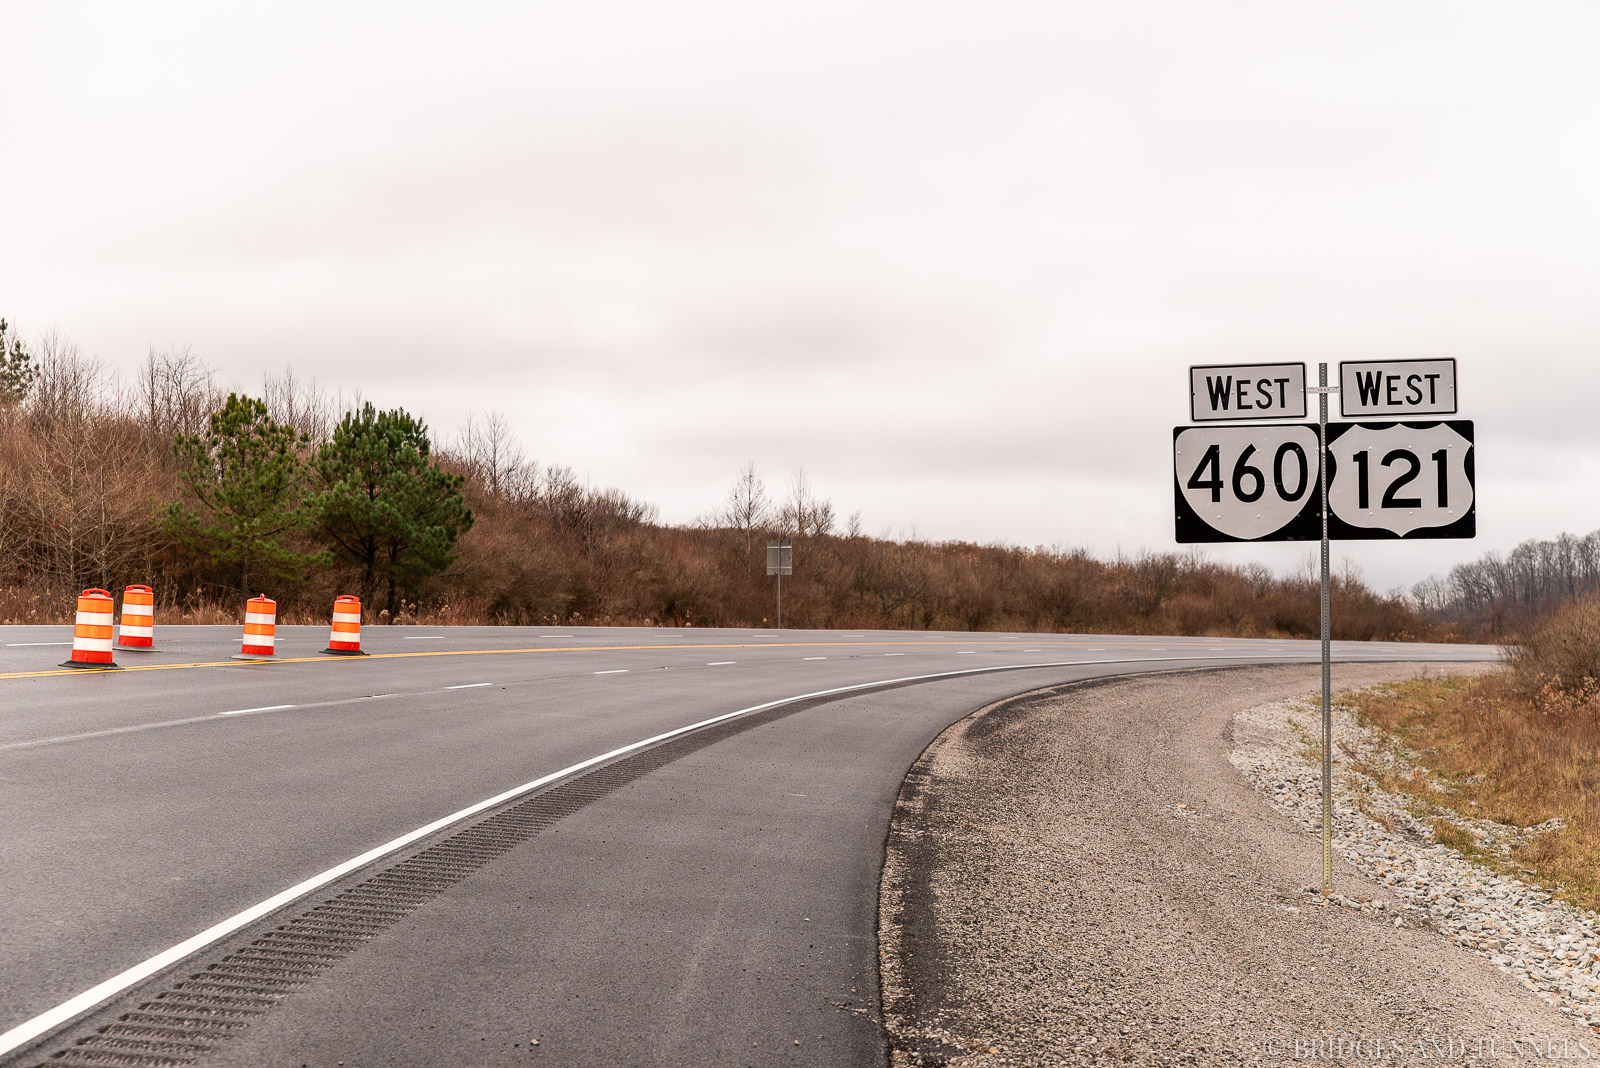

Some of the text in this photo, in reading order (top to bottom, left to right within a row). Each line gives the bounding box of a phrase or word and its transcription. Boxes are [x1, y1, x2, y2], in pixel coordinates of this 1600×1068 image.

[1206, 375, 1290, 411] WEST
[1355, 371, 1440, 407] WEST
[1187, 441, 1309, 503] 460
[1352, 448, 1449, 509] 121
